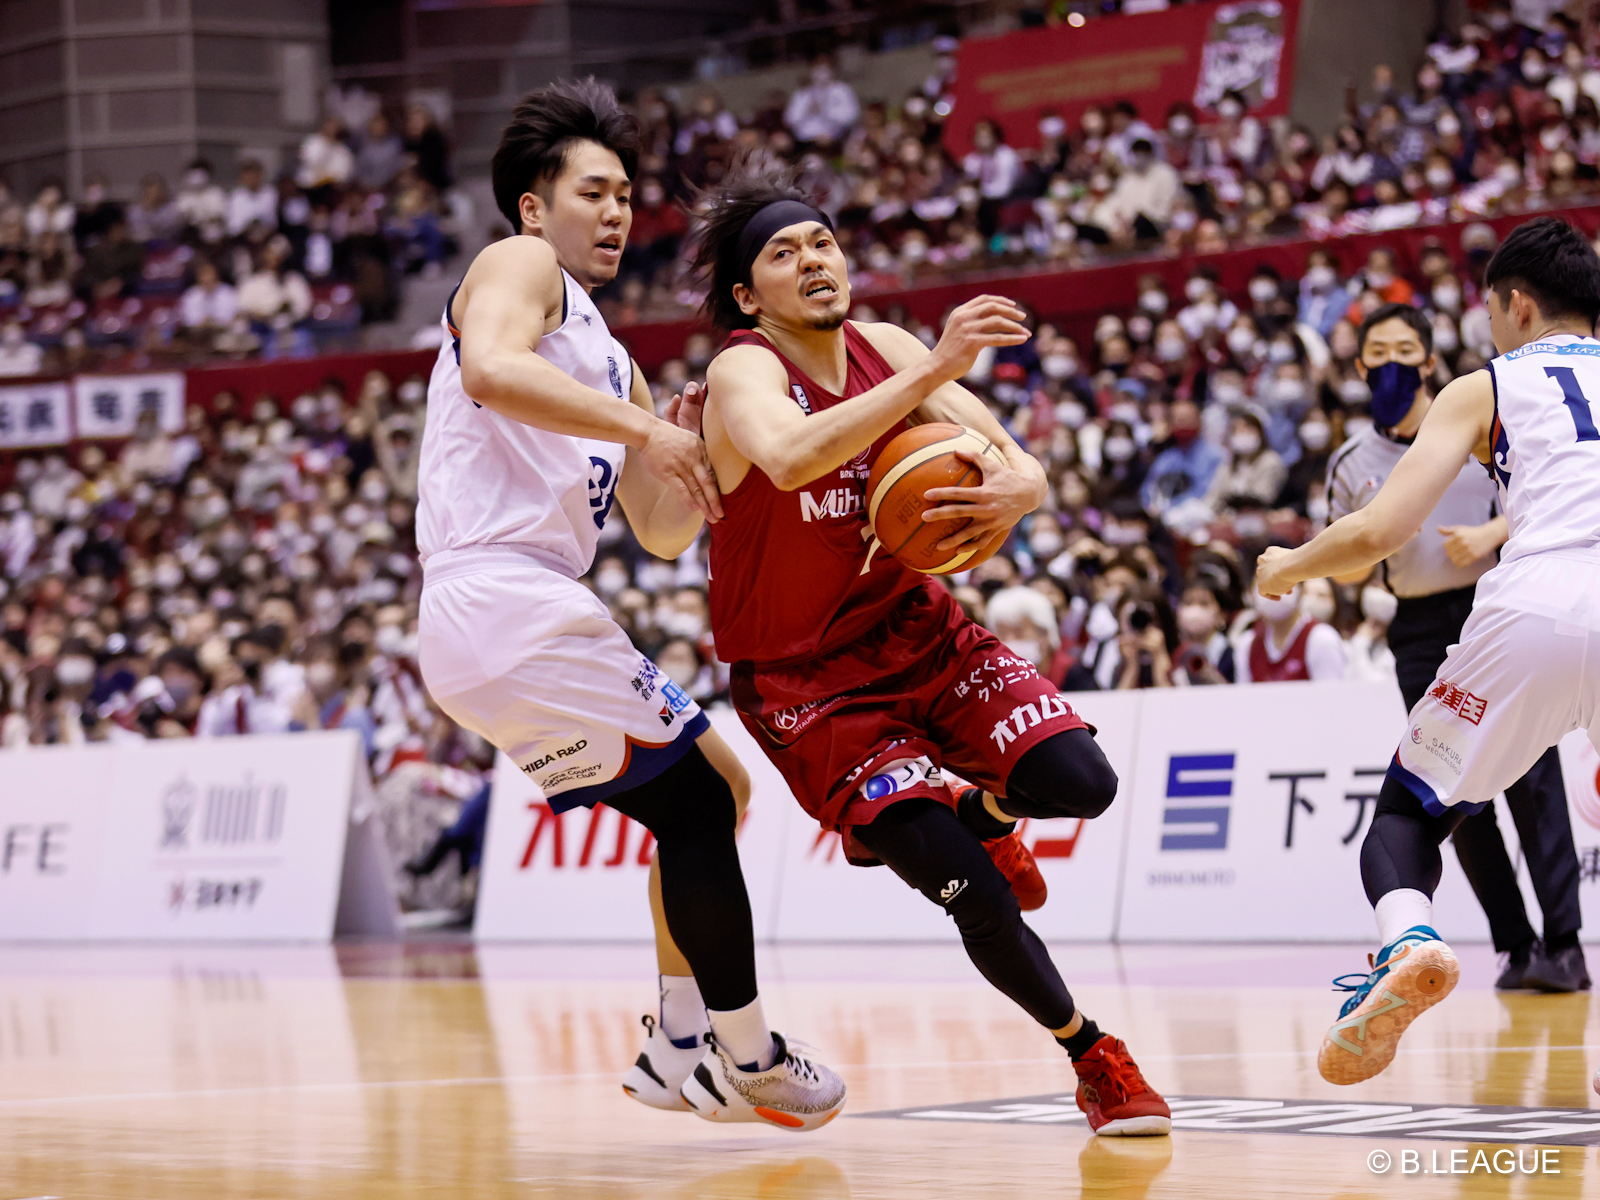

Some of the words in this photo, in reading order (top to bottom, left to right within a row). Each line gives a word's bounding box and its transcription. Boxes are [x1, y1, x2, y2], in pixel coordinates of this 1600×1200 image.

[1508, 343, 1559, 359] WEINS
[1543, 366, 1600, 443] 1
[896, 493, 924, 525] FIBA
[791, 711, 819, 735] KITAURA
[556, 738, 588, 759] R&D
[1431, 737, 1462, 765] SAKURA
[567, 762, 602, 776] Country
[576, 770, 597, 780] Club
[1267, 768, 1389, 848] 下元
[2, 822, 70, 874] FE
